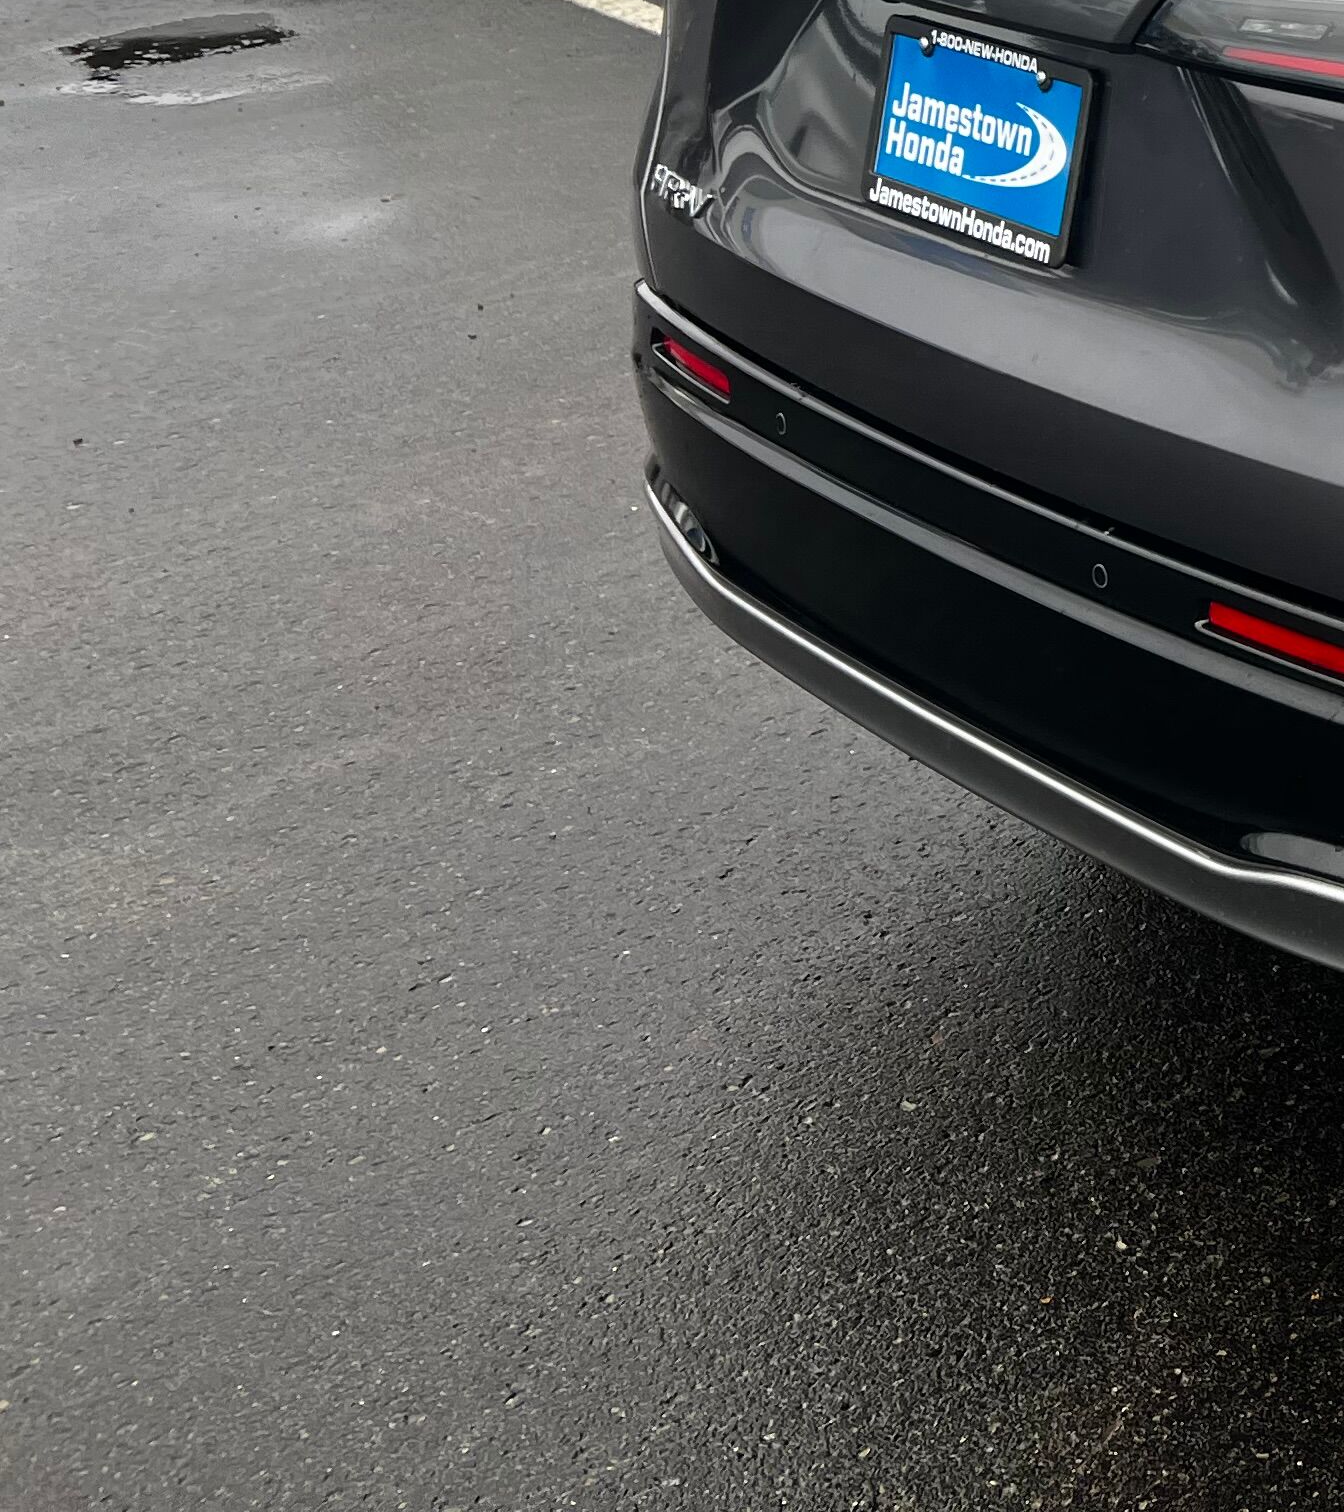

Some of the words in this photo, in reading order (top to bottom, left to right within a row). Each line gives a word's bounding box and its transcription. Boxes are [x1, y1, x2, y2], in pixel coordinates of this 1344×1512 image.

[931, 29, 1039, 74] 1-800-NEW-HONDA
[885, 117, 965, 177] Honda
[892, 82, 1033, 157] Jamestown
[869, 178, 1050, 264] JamestownHonda.com
